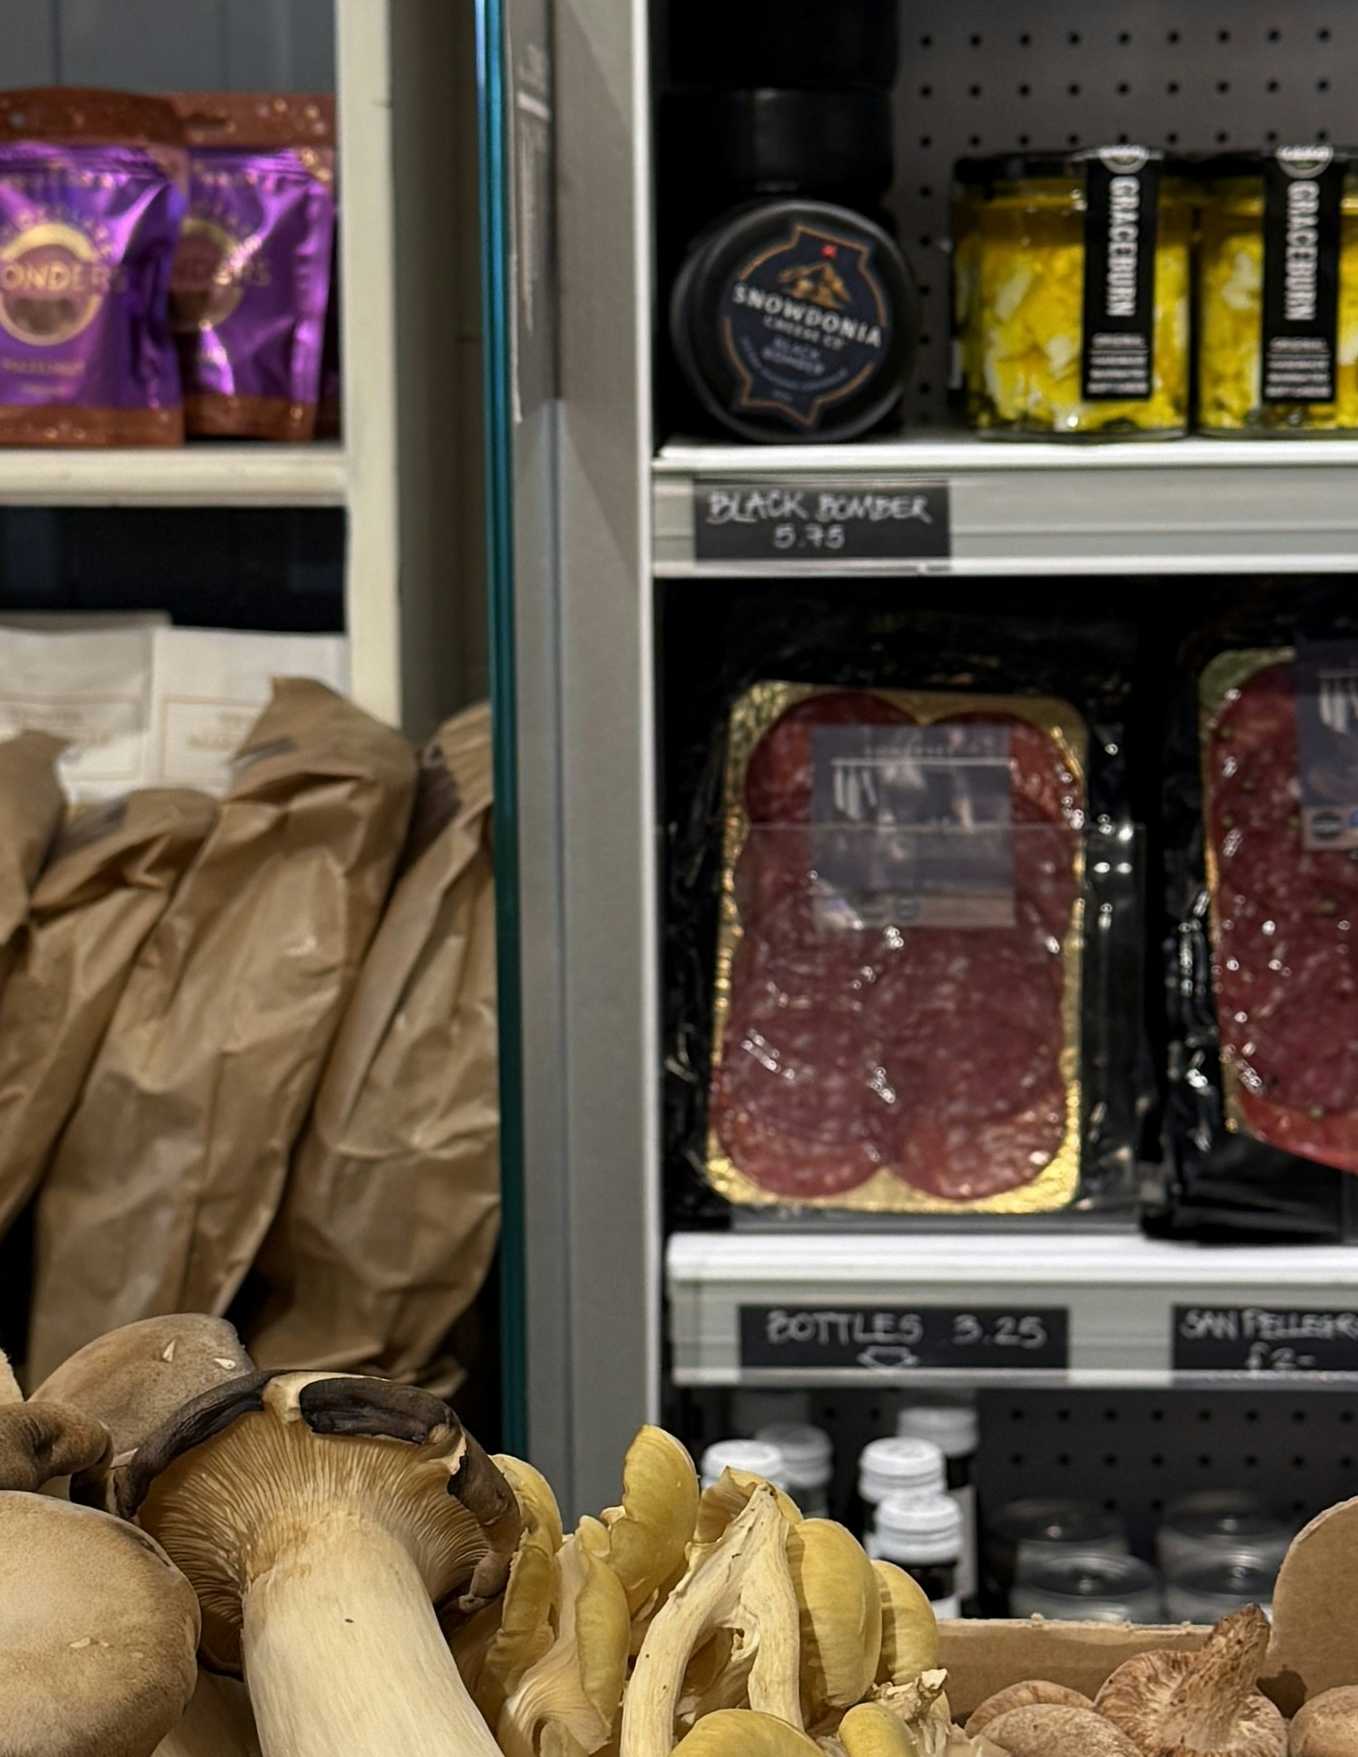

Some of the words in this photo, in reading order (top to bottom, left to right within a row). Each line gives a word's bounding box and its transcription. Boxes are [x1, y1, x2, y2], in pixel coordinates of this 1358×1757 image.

[1106, 175, 1141, 318] GRACEBURN
[1284, 179, 1321, 322] GRACEBURN
[732, 281, 882, 349] SNOWDONIA
[706, 491, 810, 523] BLACK
[814, 492, 932, 523] BOMBER
[773, 522, 848, 549] 5.75
[764, 1310, 926, 1345] BOTTLES
[949, 1313, 1048, 1348] 3.25
[1179, 1308, 1239, 1340] SAN
